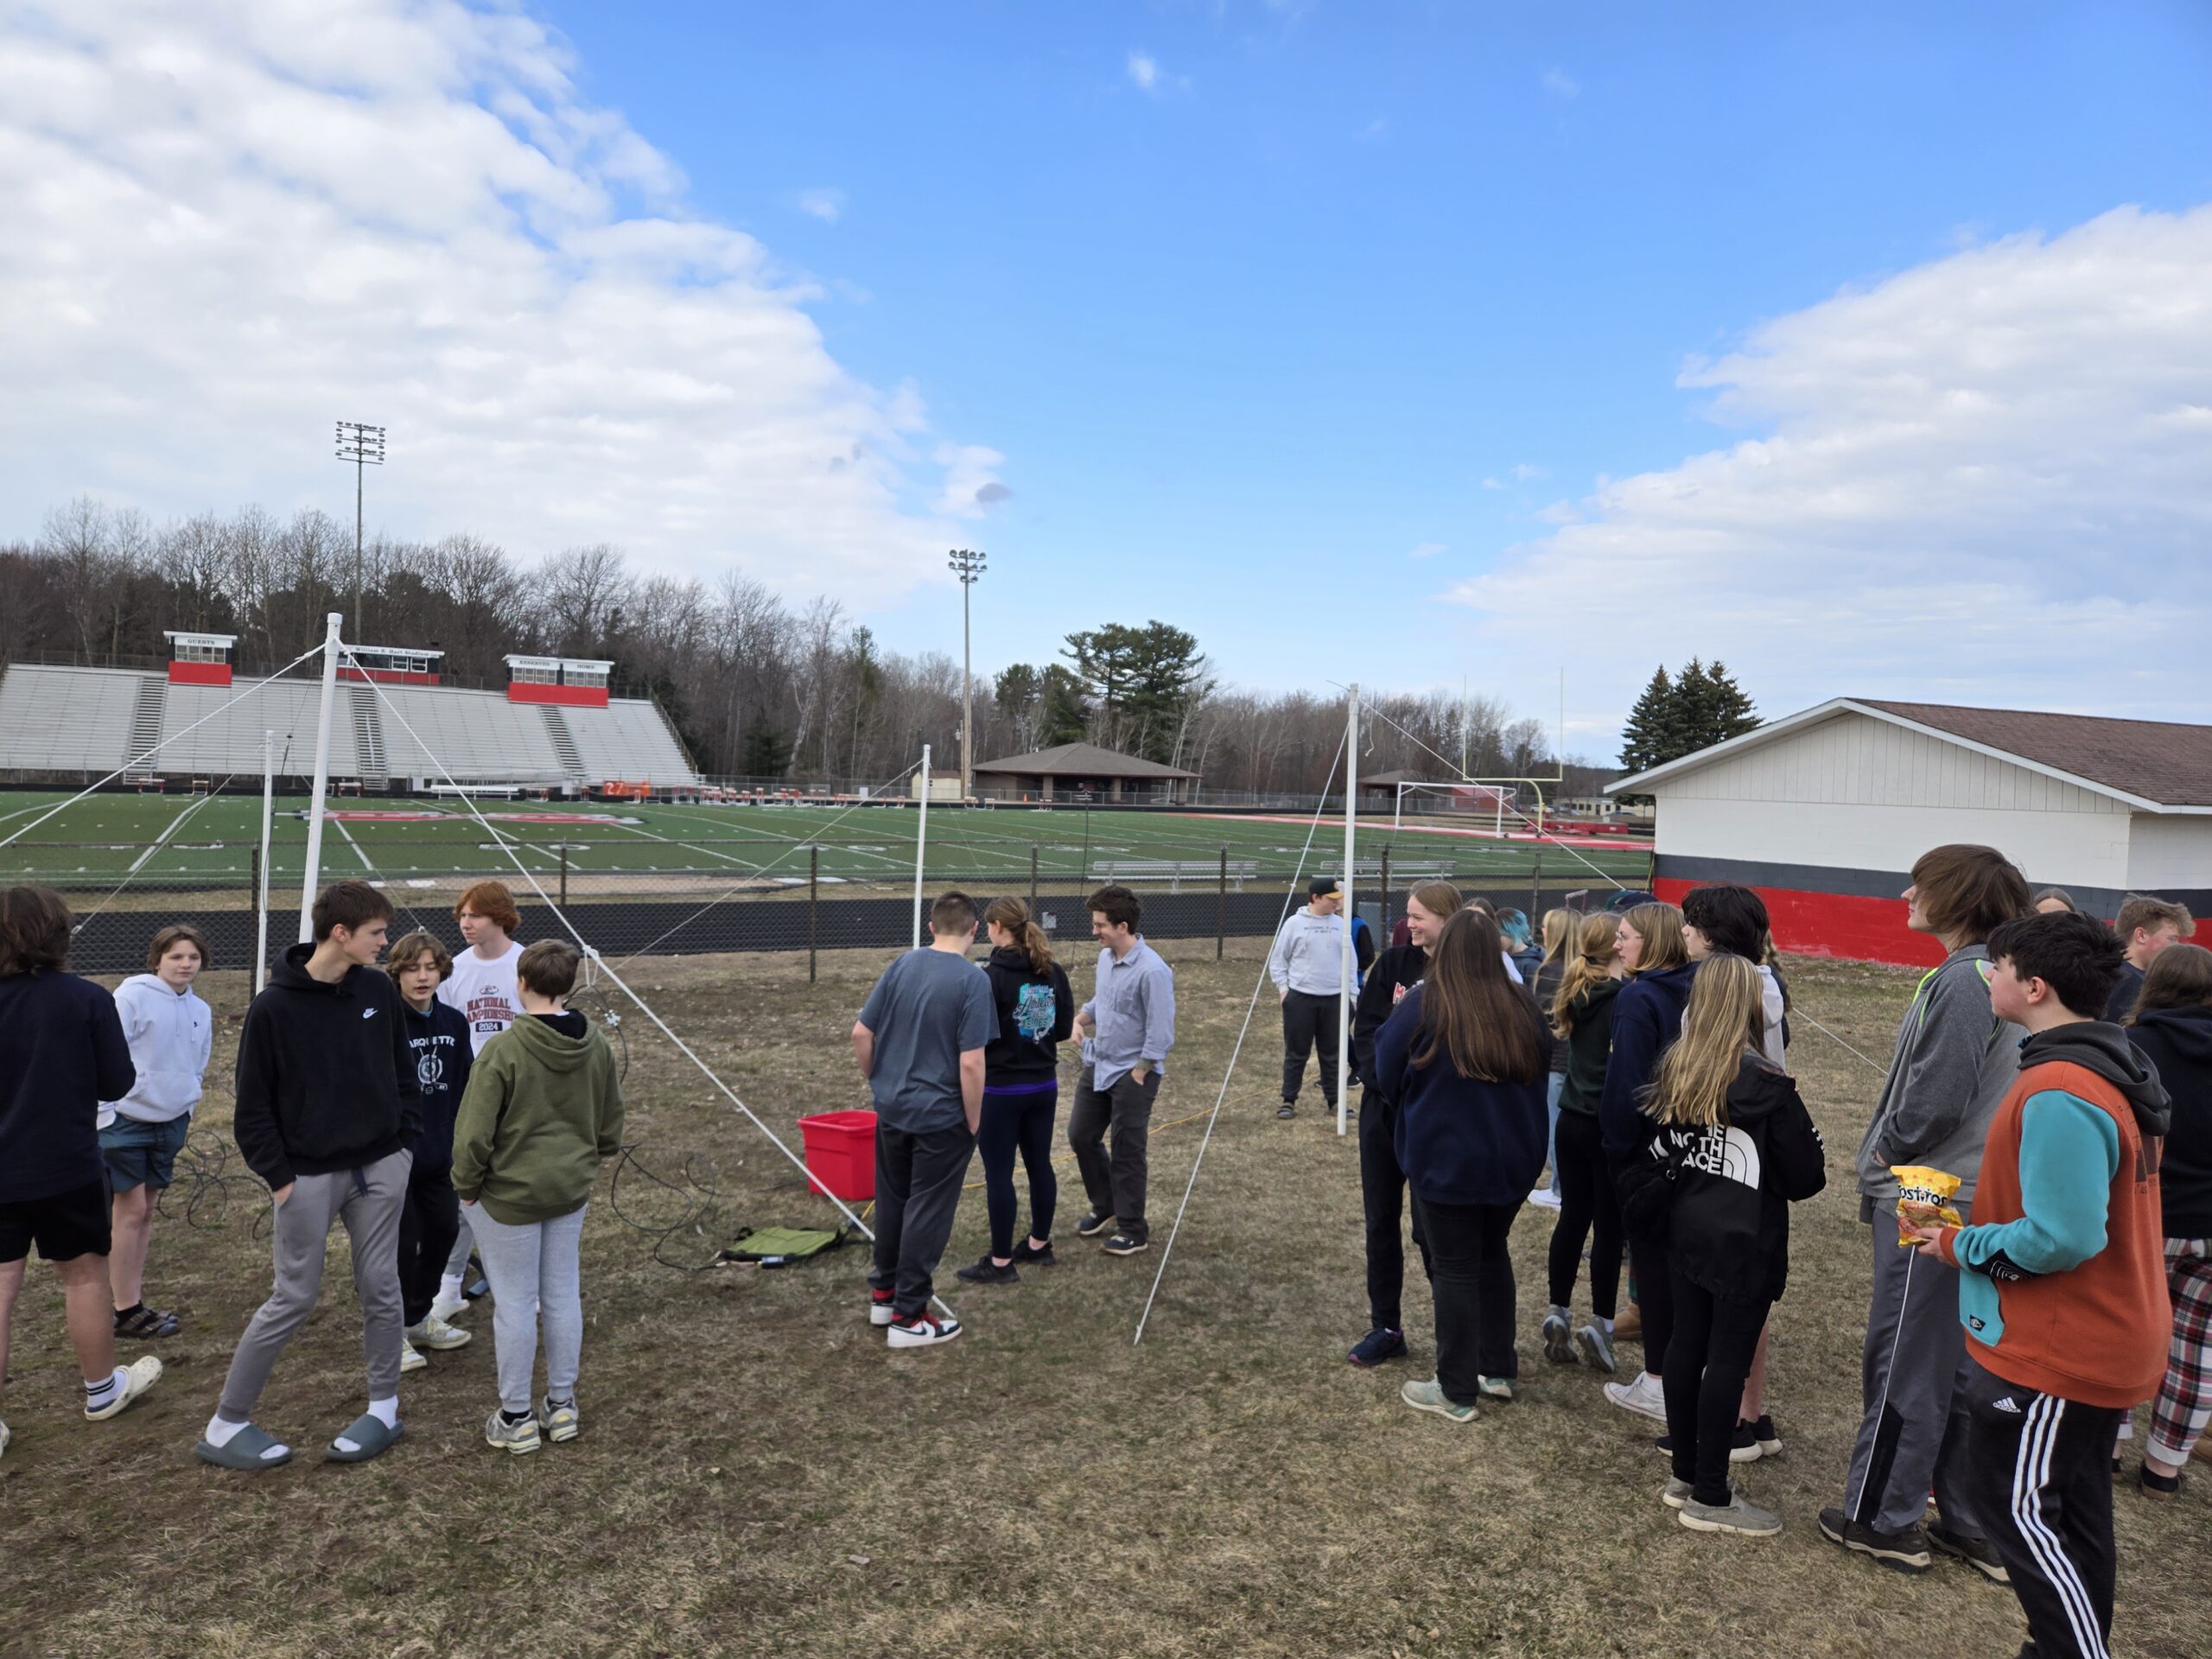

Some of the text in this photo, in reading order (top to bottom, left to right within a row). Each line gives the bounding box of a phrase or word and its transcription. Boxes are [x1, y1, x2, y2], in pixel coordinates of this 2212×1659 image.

[467, 996, 511, 1012] NATIONAL
[467, 1008, 517, 1023] AMPIONSHI
[479, 1022, 499, 1031] 2024
[409, 1035, 456, 1048] ARQETTE
[1681, 1151, 1723, 1175] ACE
